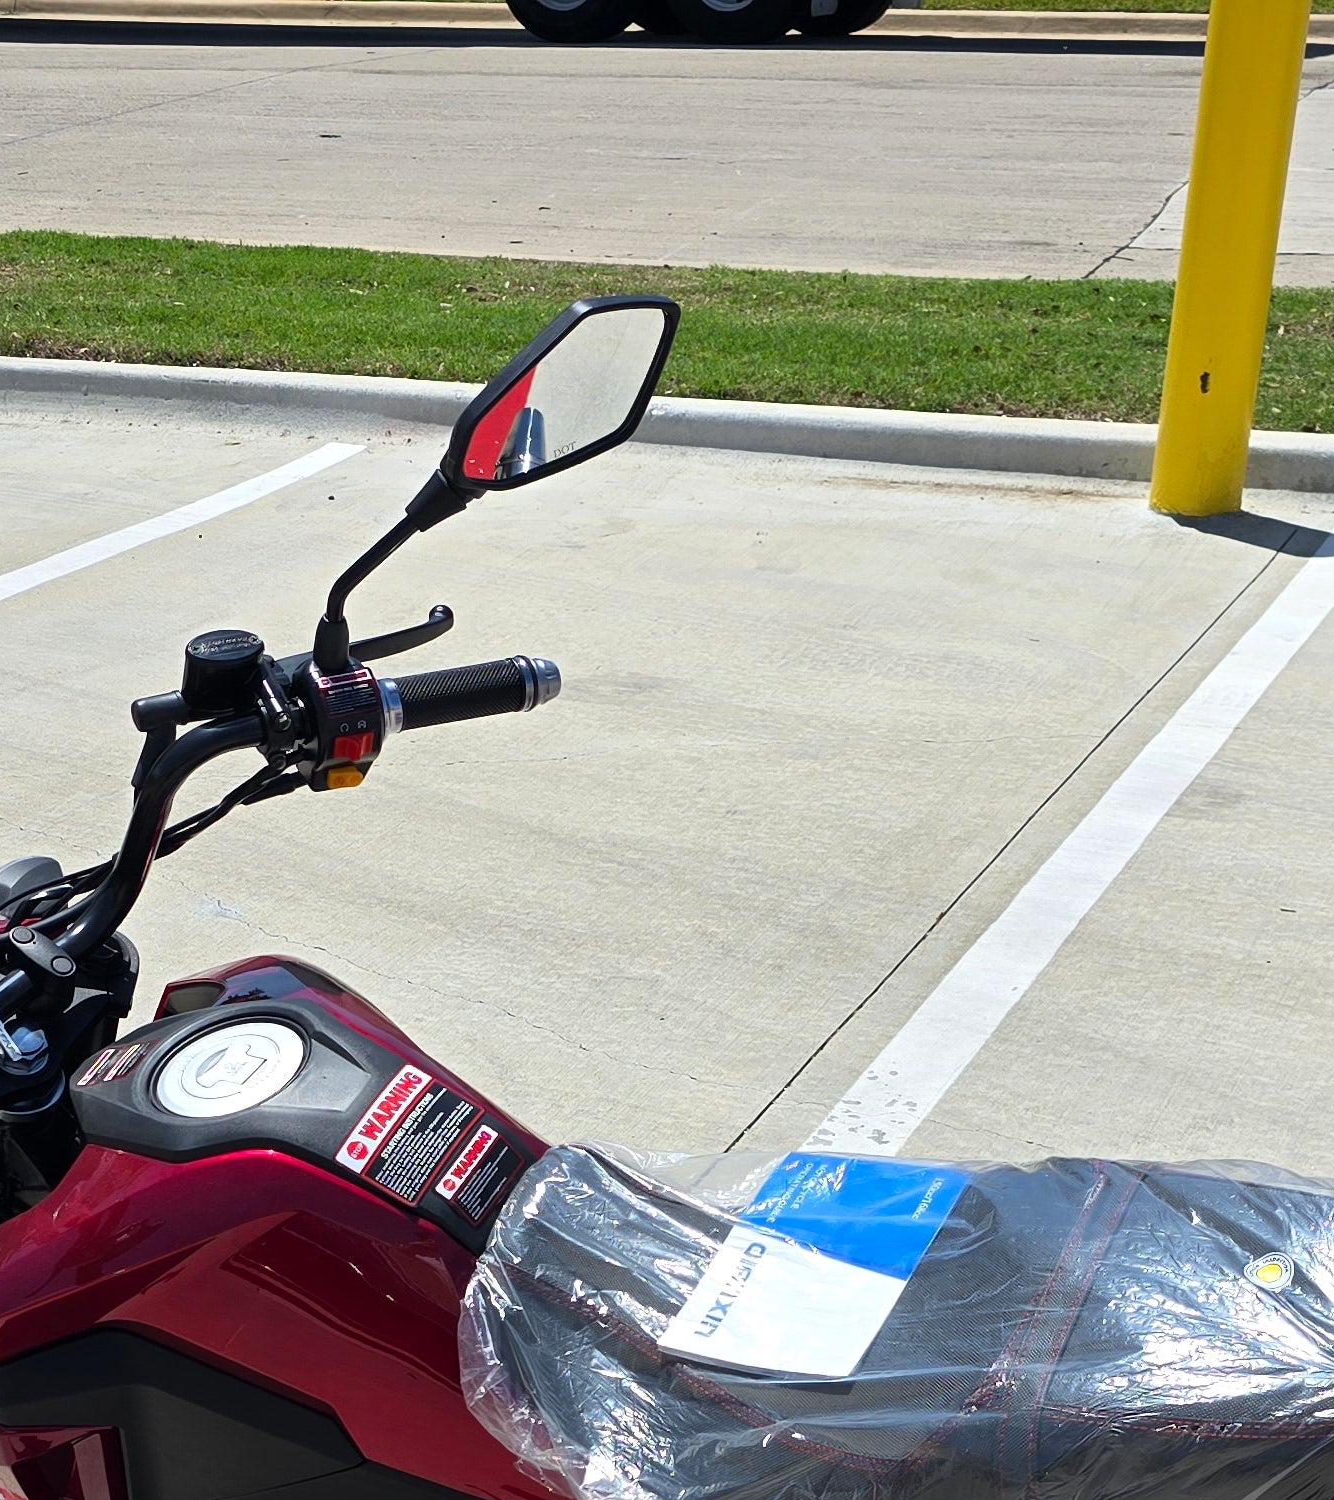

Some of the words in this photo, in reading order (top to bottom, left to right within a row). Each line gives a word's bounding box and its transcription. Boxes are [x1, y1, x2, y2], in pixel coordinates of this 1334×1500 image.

[553, 441, 577, 458] DOT
[358, 1071, 423, 1141] WARNING
[380, 1127, 407, 1160] STARTING
[450, 1130, 493, 1180] WARNING
